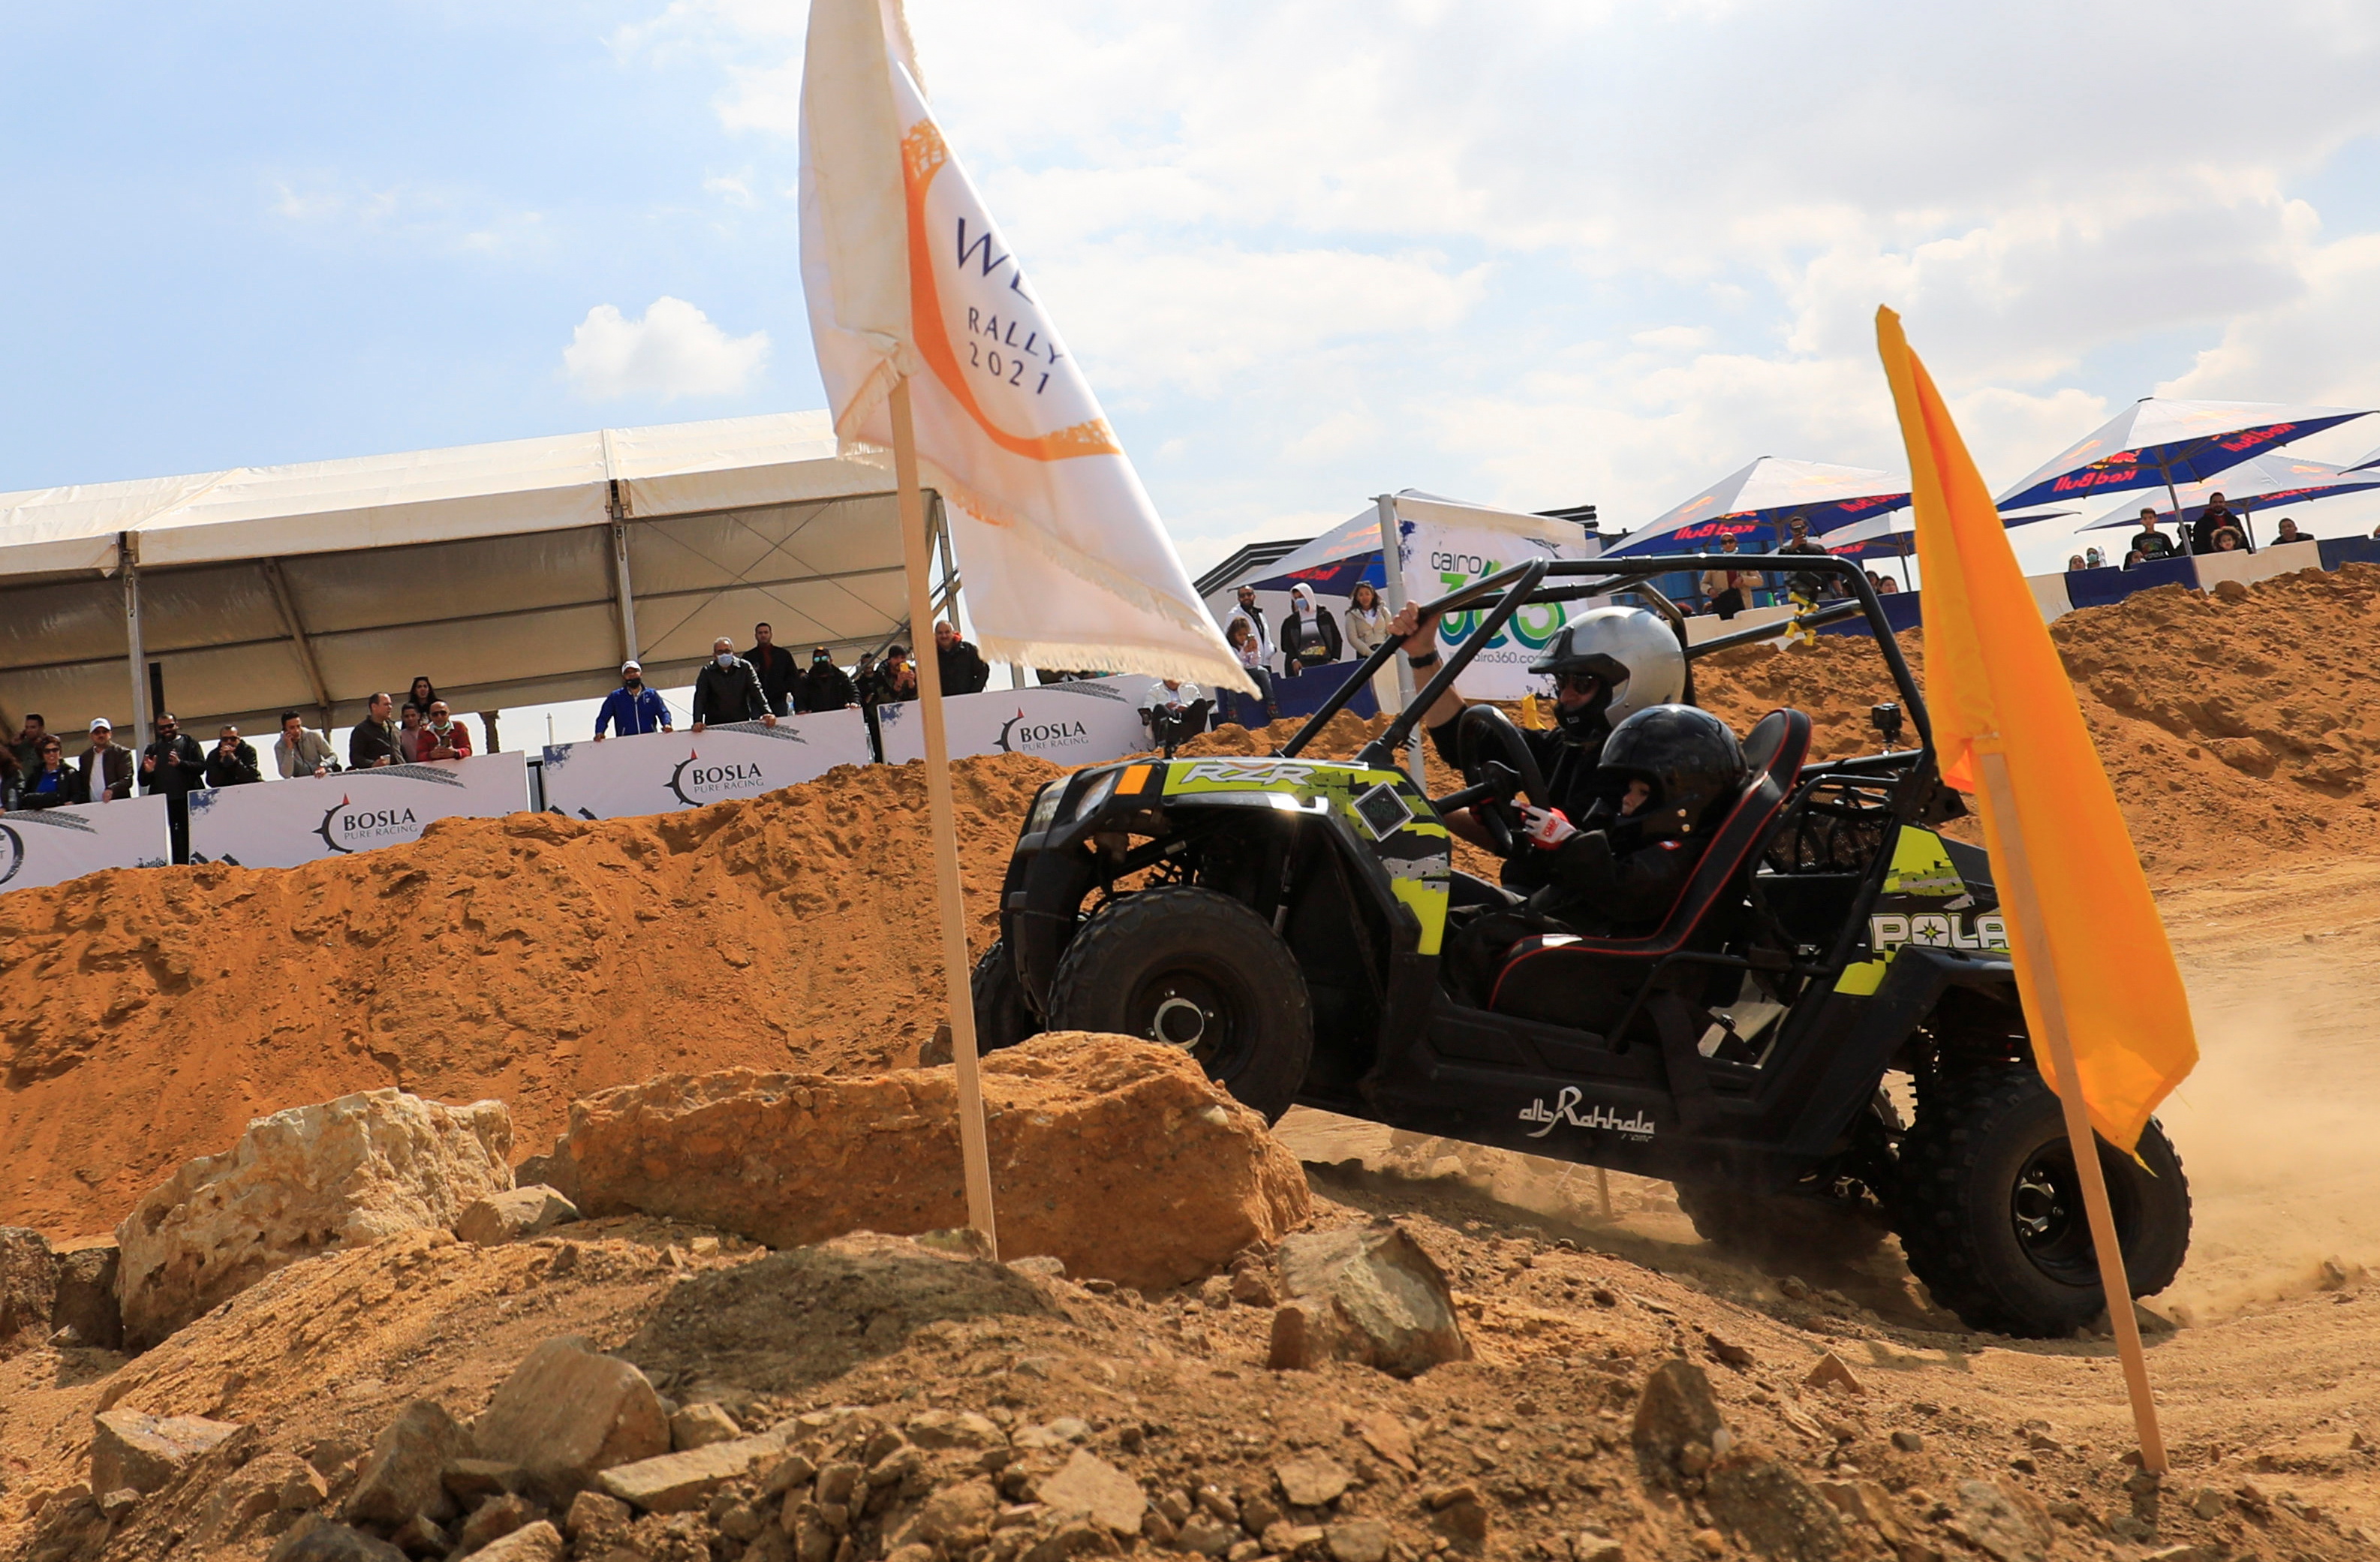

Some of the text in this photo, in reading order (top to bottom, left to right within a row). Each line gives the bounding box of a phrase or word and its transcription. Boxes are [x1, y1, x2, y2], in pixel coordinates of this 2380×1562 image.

[968, 307, 1063, 365] RALLY
[969, 342, 1049, 394] 2021
[1431, 551, 1482, 574] cairo
[1019, 721, 1087, 743] BOSLA
[1022, 736, 1089, 751] PURE RACING
[692, 763, 763, 785] BOSLA
[1178, 760, 1316, 787] RZR
[694, 778, 764, 795] PURE RACING
[344, 808, 417, 831] BOSLA
[345, 824, 418, 840] PURE RACING
[1869, 913, 2011, 953] POLA
